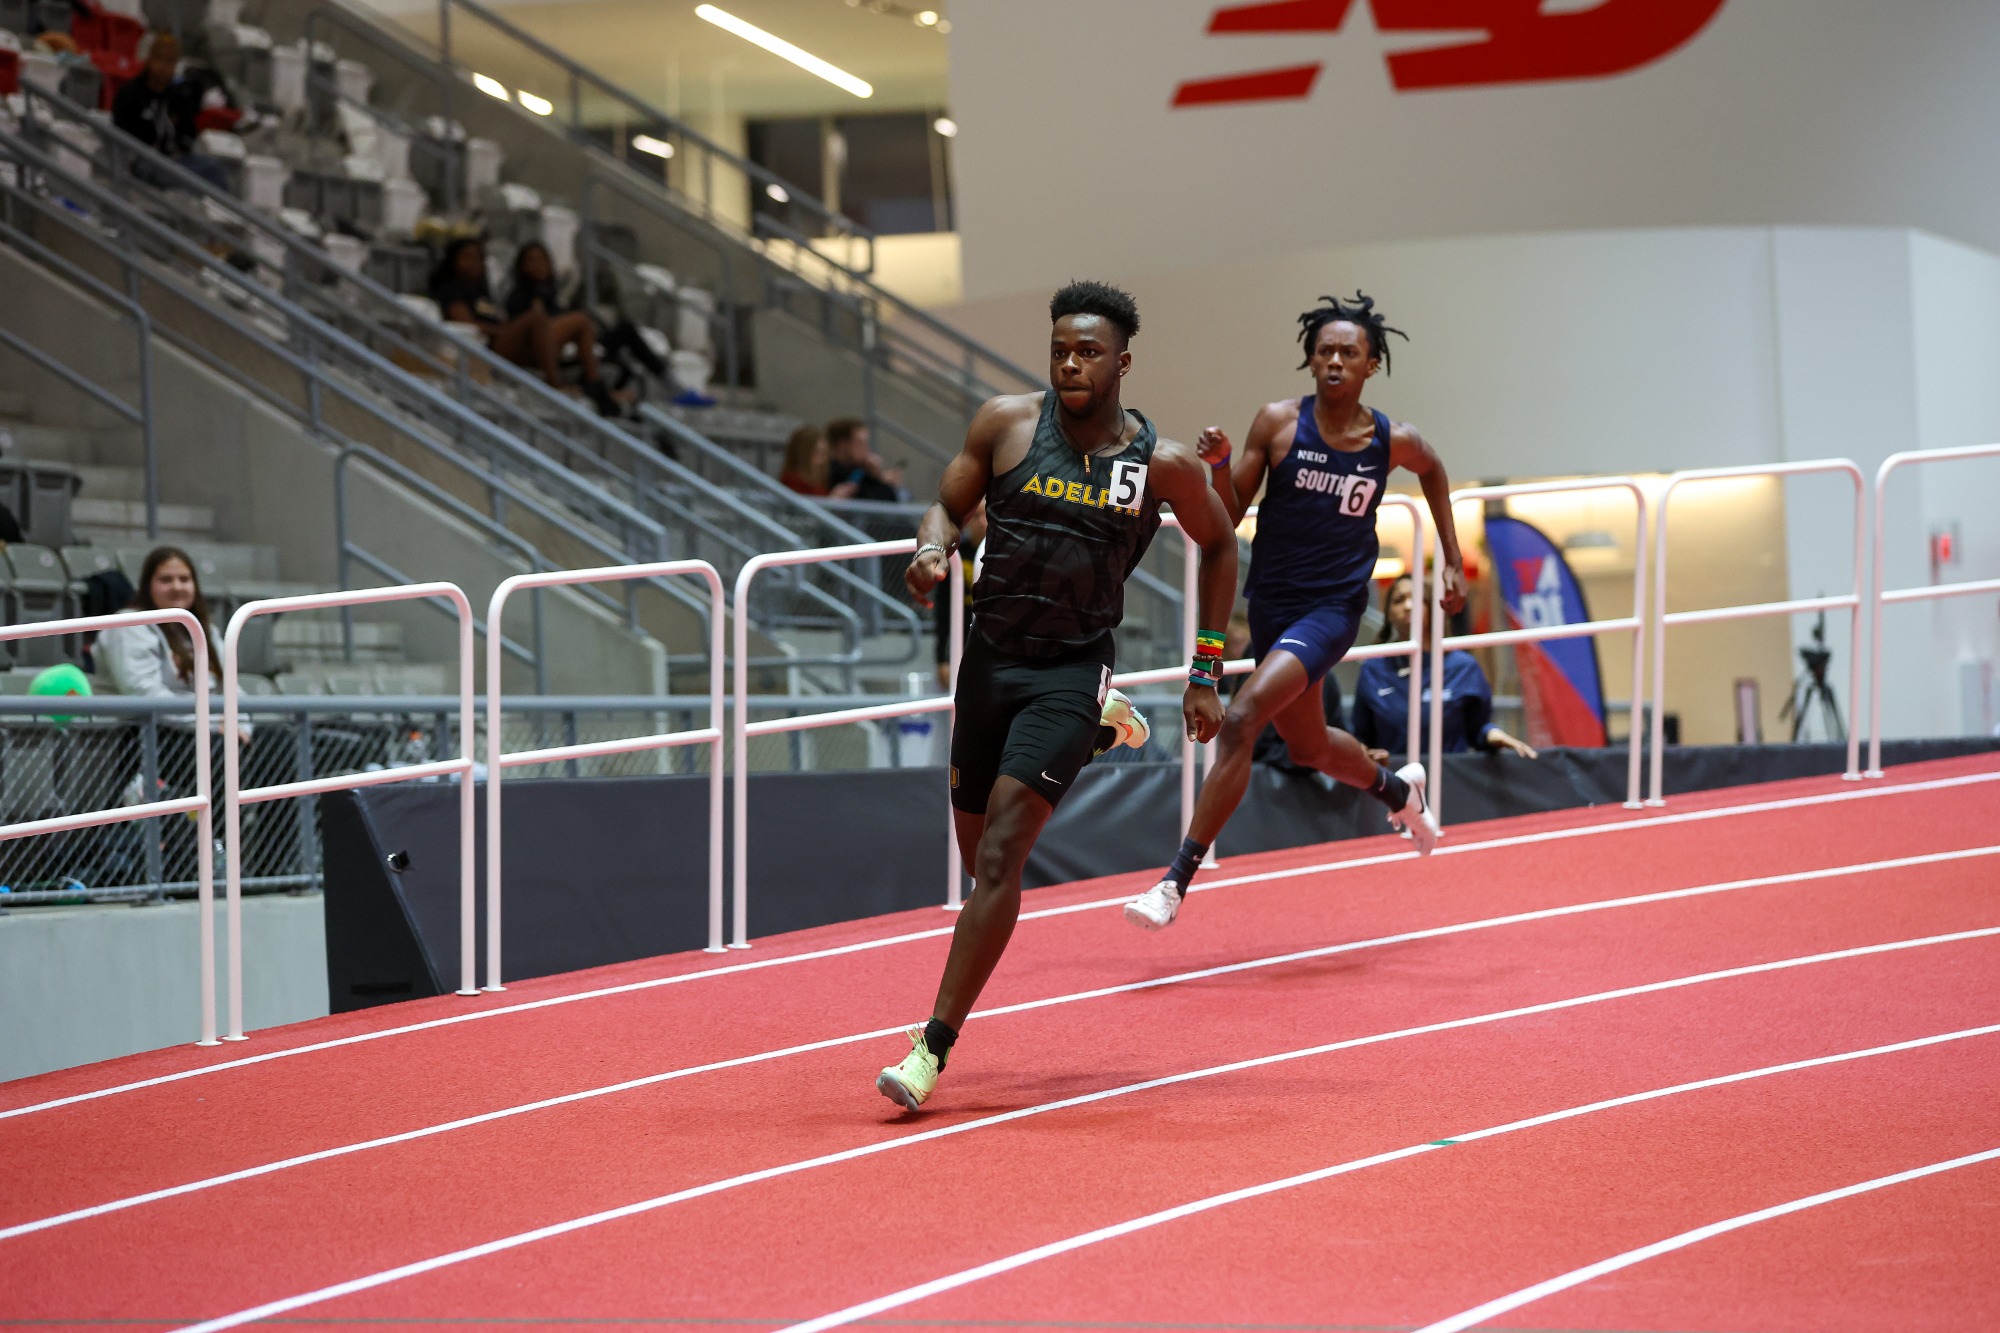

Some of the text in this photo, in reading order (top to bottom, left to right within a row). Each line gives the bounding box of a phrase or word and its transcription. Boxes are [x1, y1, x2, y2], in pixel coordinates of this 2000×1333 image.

[1021, 473, 1140, 518] ADELP
[1116, 465, 1140, 506] 5
[1347, 480, 1368, 513] 6
